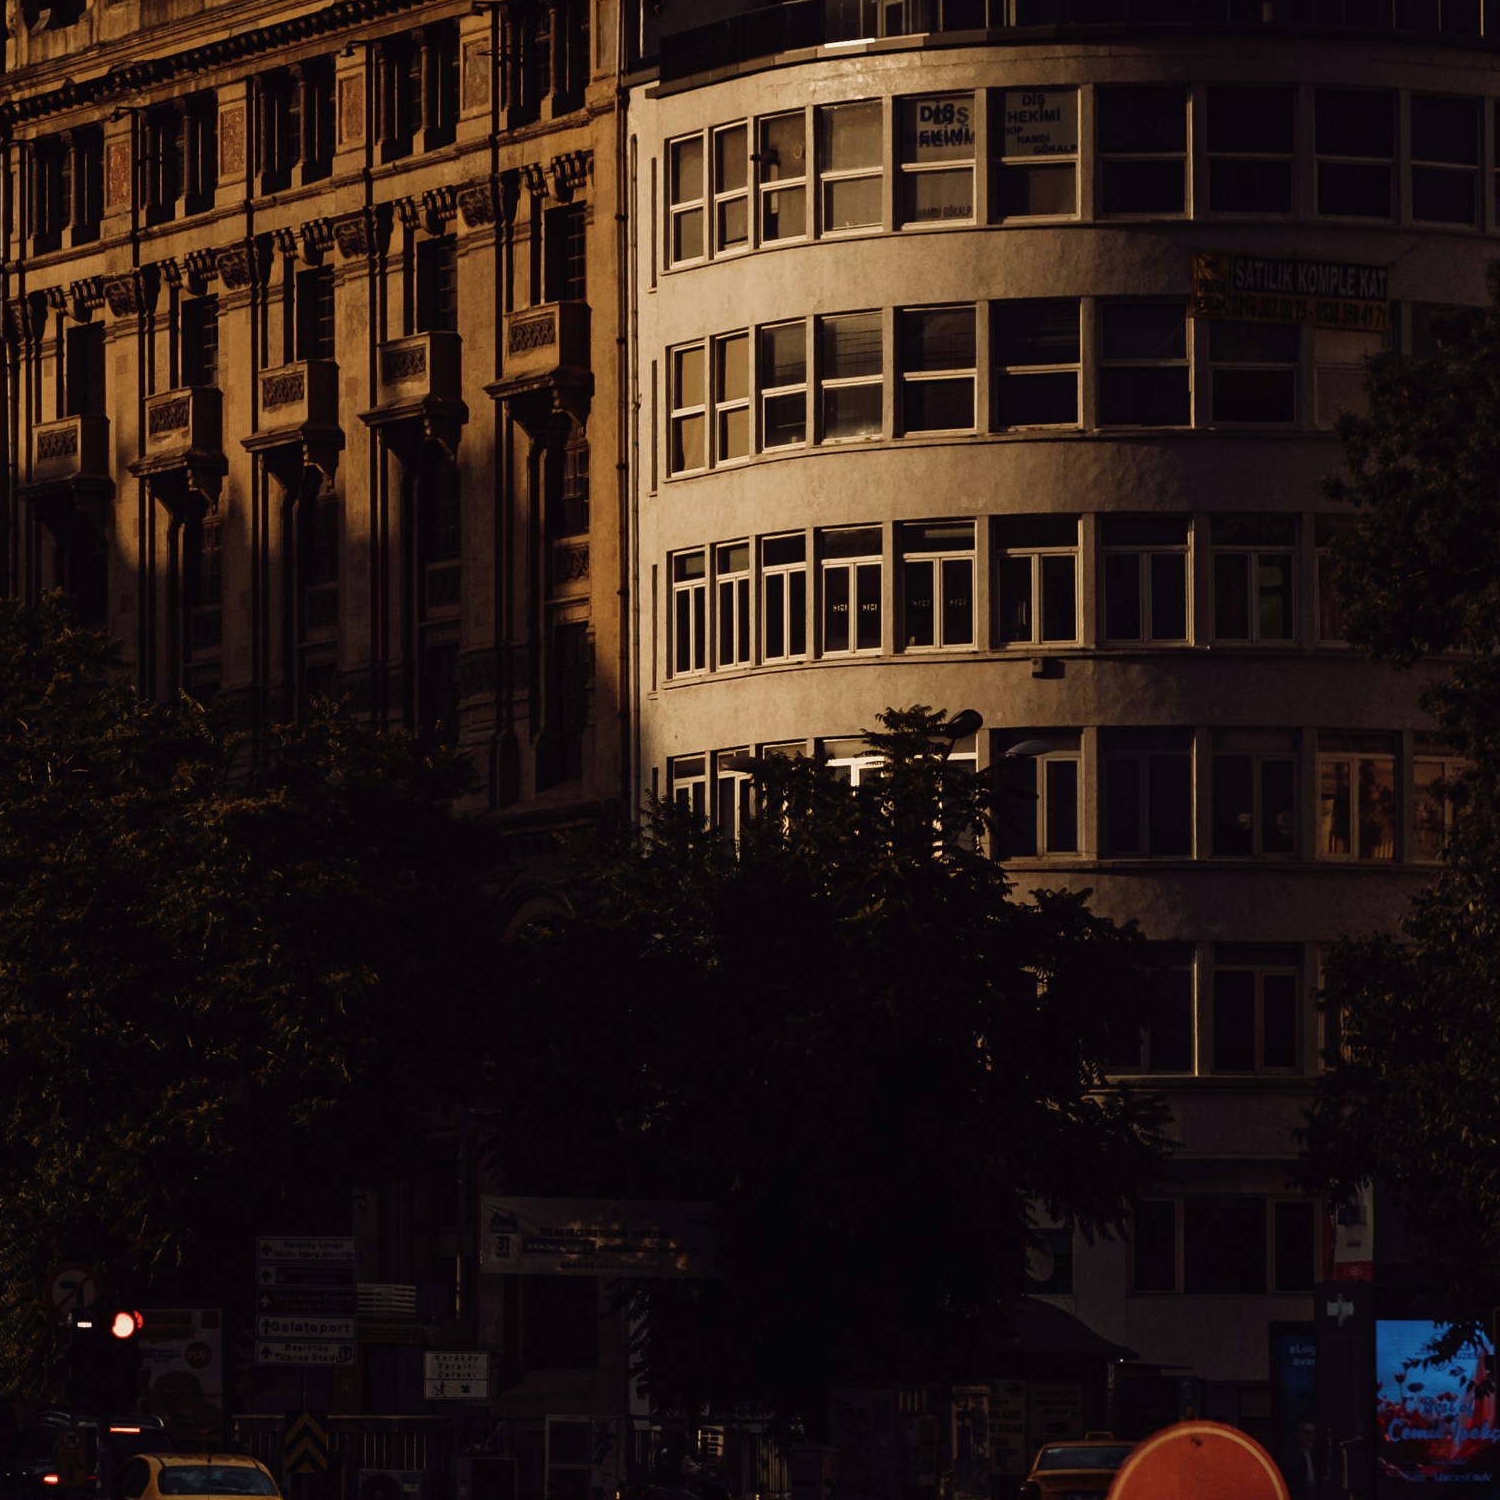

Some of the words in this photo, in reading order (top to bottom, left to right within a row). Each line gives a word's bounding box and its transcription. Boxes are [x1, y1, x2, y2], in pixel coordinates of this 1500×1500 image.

[1008, 106, 1060, 124] HEKİMİ
[1235, 259, 1293, 292] SATILIK
[1299, 263, 1356, 297] KOMPLE
[1359, 267, 1387, 299] KAT
[496, 1236, 510, 1251] 31
[271, 1321, 350, 1334] Galataport
